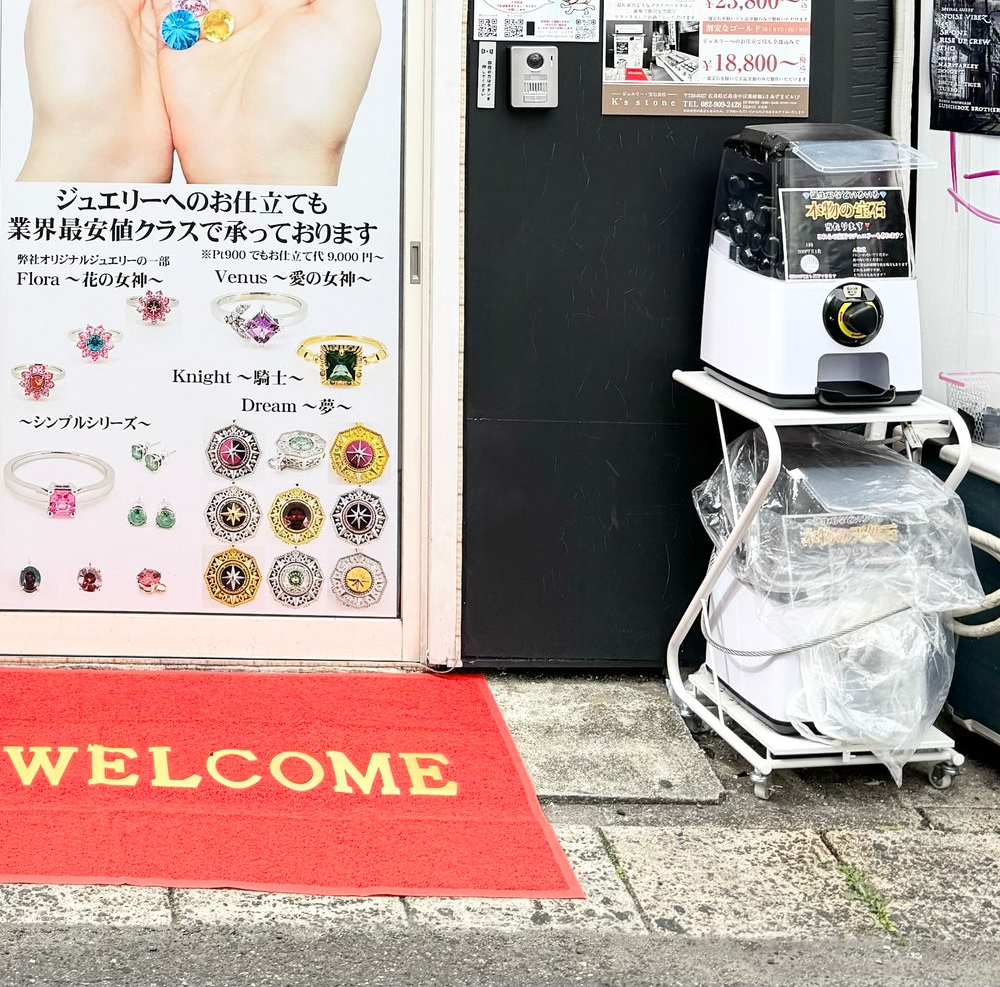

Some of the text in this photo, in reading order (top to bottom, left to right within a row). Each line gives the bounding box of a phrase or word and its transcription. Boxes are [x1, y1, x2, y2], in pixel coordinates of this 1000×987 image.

[683, 100, 699, 108] TEL
[56, 188, 328, 215] ジュエリーへのお仕立ても
[804, 200, 887, 220] 本物の宝石
[8, 216, 378, 245] 業界最安値クラスで承っております
[18, 254, 169, 266] 弊社オリジナルジュエリーの一部
[249, 250, 325, 261] でもお仕立て代
[18, 272, 59, 285] Flora
[215, 270, 267, 283] Venus
[173, 370, 230, 384] Knight
[242, 399, 296, 412] Dream
[4, 744, 459, 797] WELCOME
